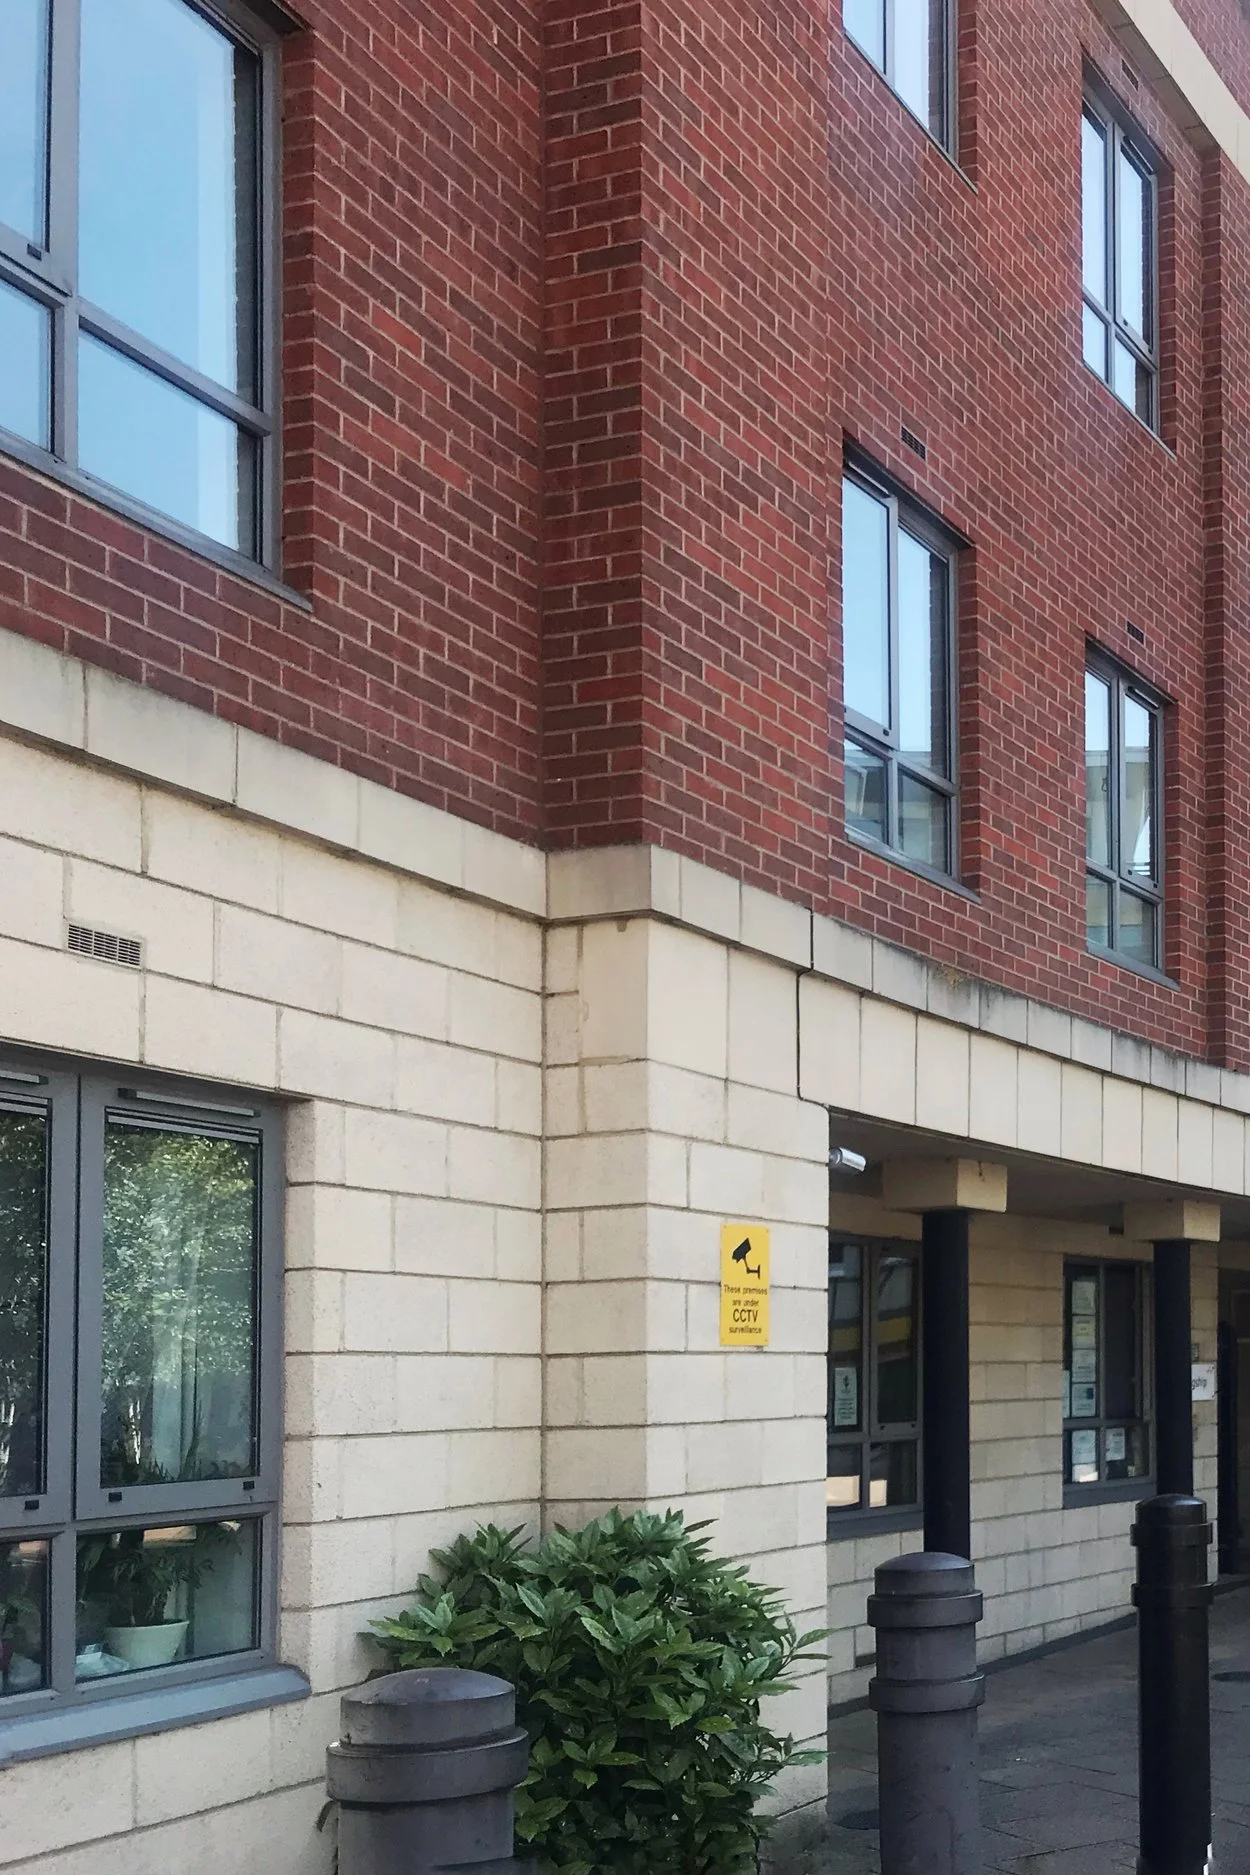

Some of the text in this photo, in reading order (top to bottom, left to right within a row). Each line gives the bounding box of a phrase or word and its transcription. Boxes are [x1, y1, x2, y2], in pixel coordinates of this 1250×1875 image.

[723, 1284, 768, 1296] These premises
[743, 1298, 759, 1307] under
[732, 1308, 759, 1323] CCTV
[729, 1325, 762, 1334] surveillance
